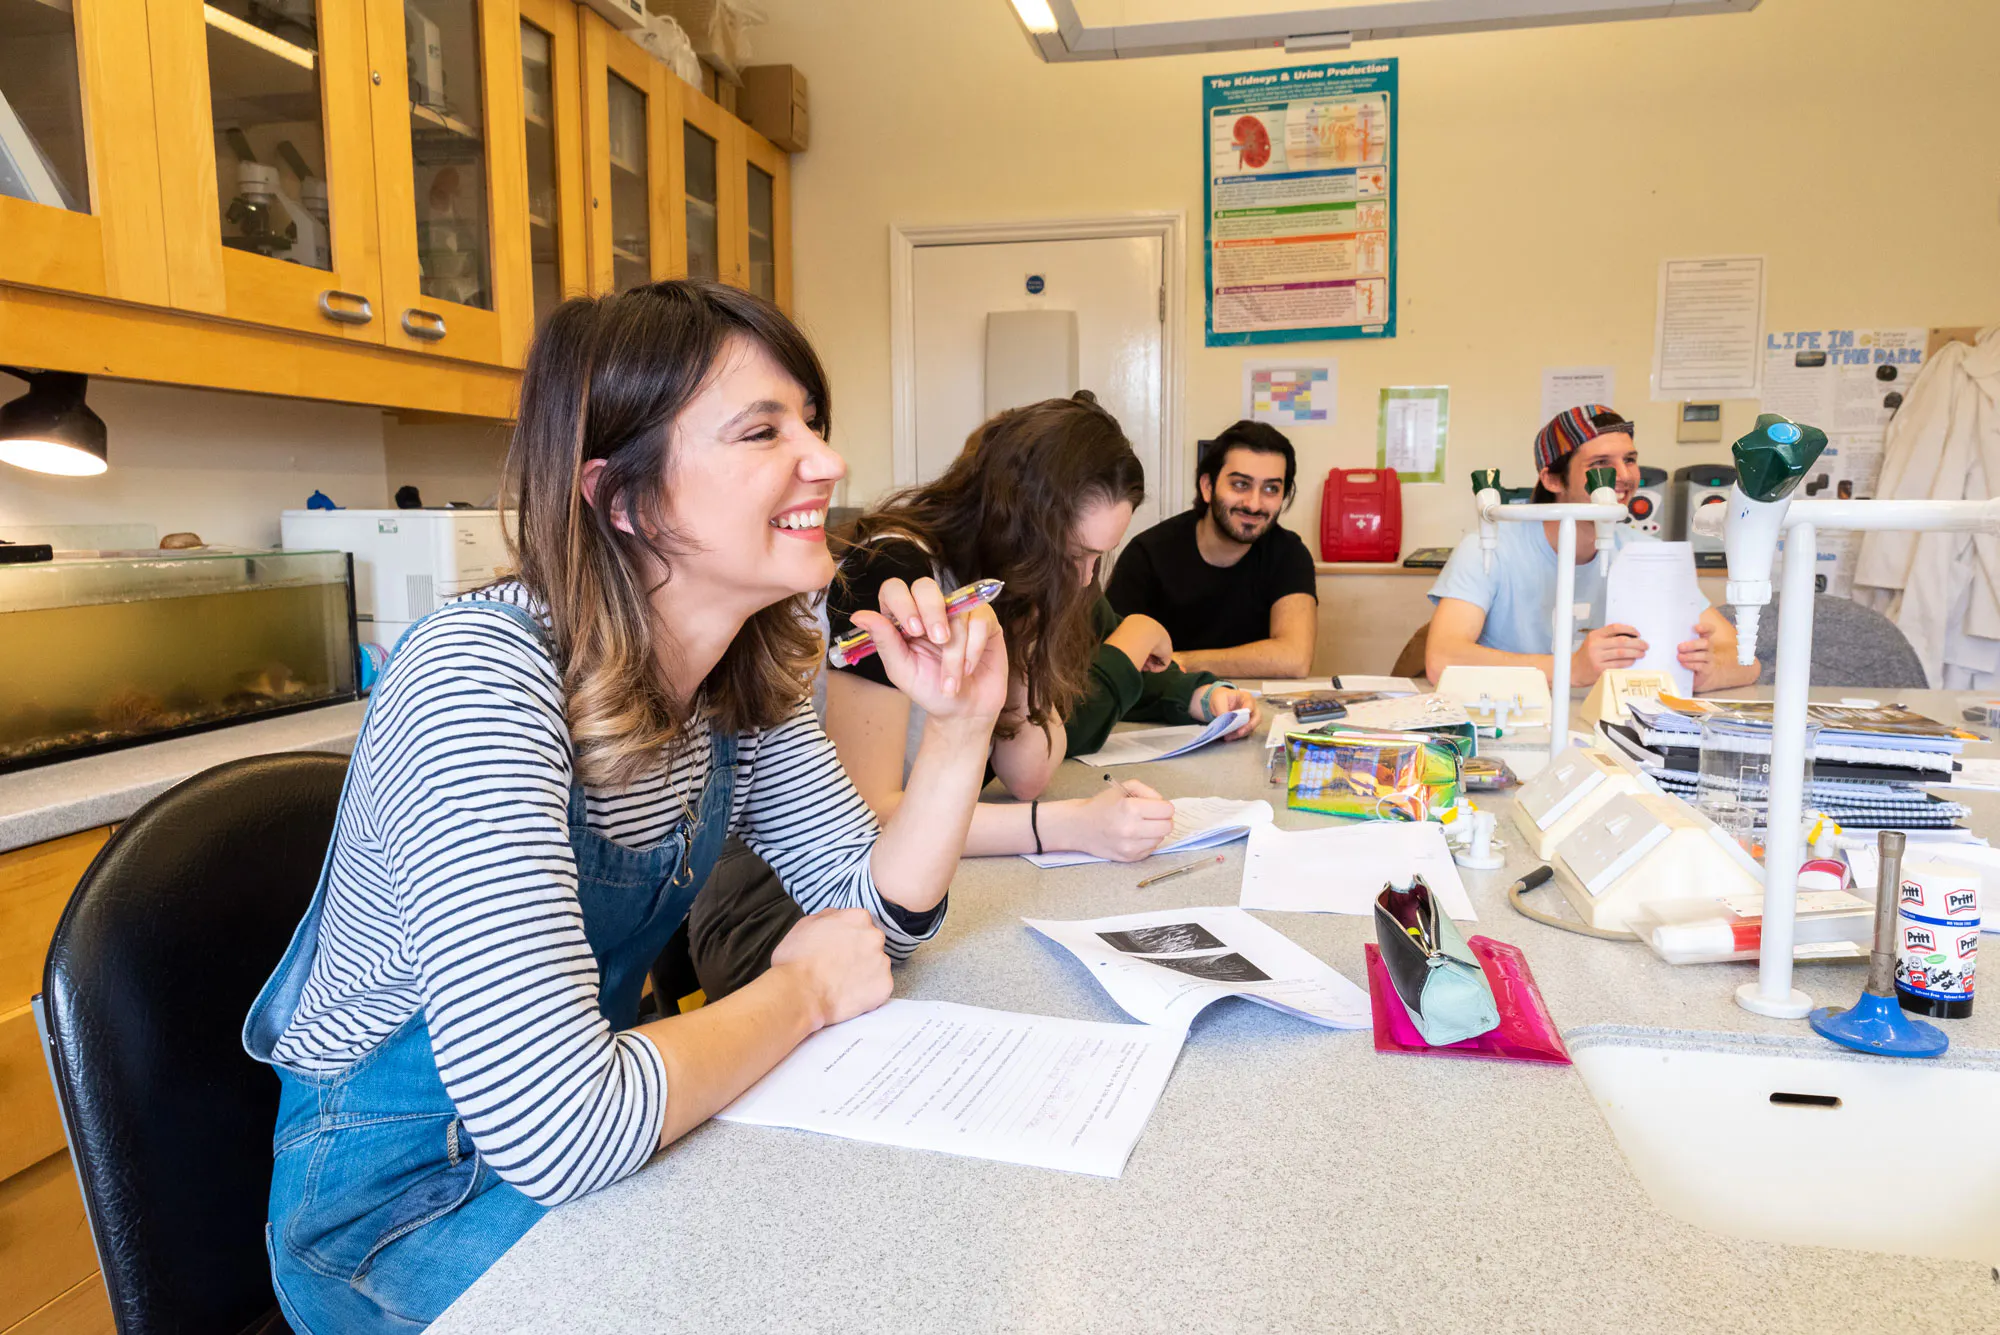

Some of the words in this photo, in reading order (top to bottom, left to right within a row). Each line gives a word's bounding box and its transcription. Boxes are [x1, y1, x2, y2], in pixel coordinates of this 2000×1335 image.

[1210, 79, 1231, 89] The
[1234, 75, 1278, 87] Kidneys
[1280, 72, 1290, 81] &
[1293, 70, 1324, 81] Urine
[1326, 63, 1390, 78] Production
[1767, 331, 1822, 350] LIFE
[1827, 330, 1854, 349] IN
[1873, 348, 1922, 365] DARK
[1950, 894, 1973, 906] Pritt
[1907, 931, 1930, 944] Pritt
